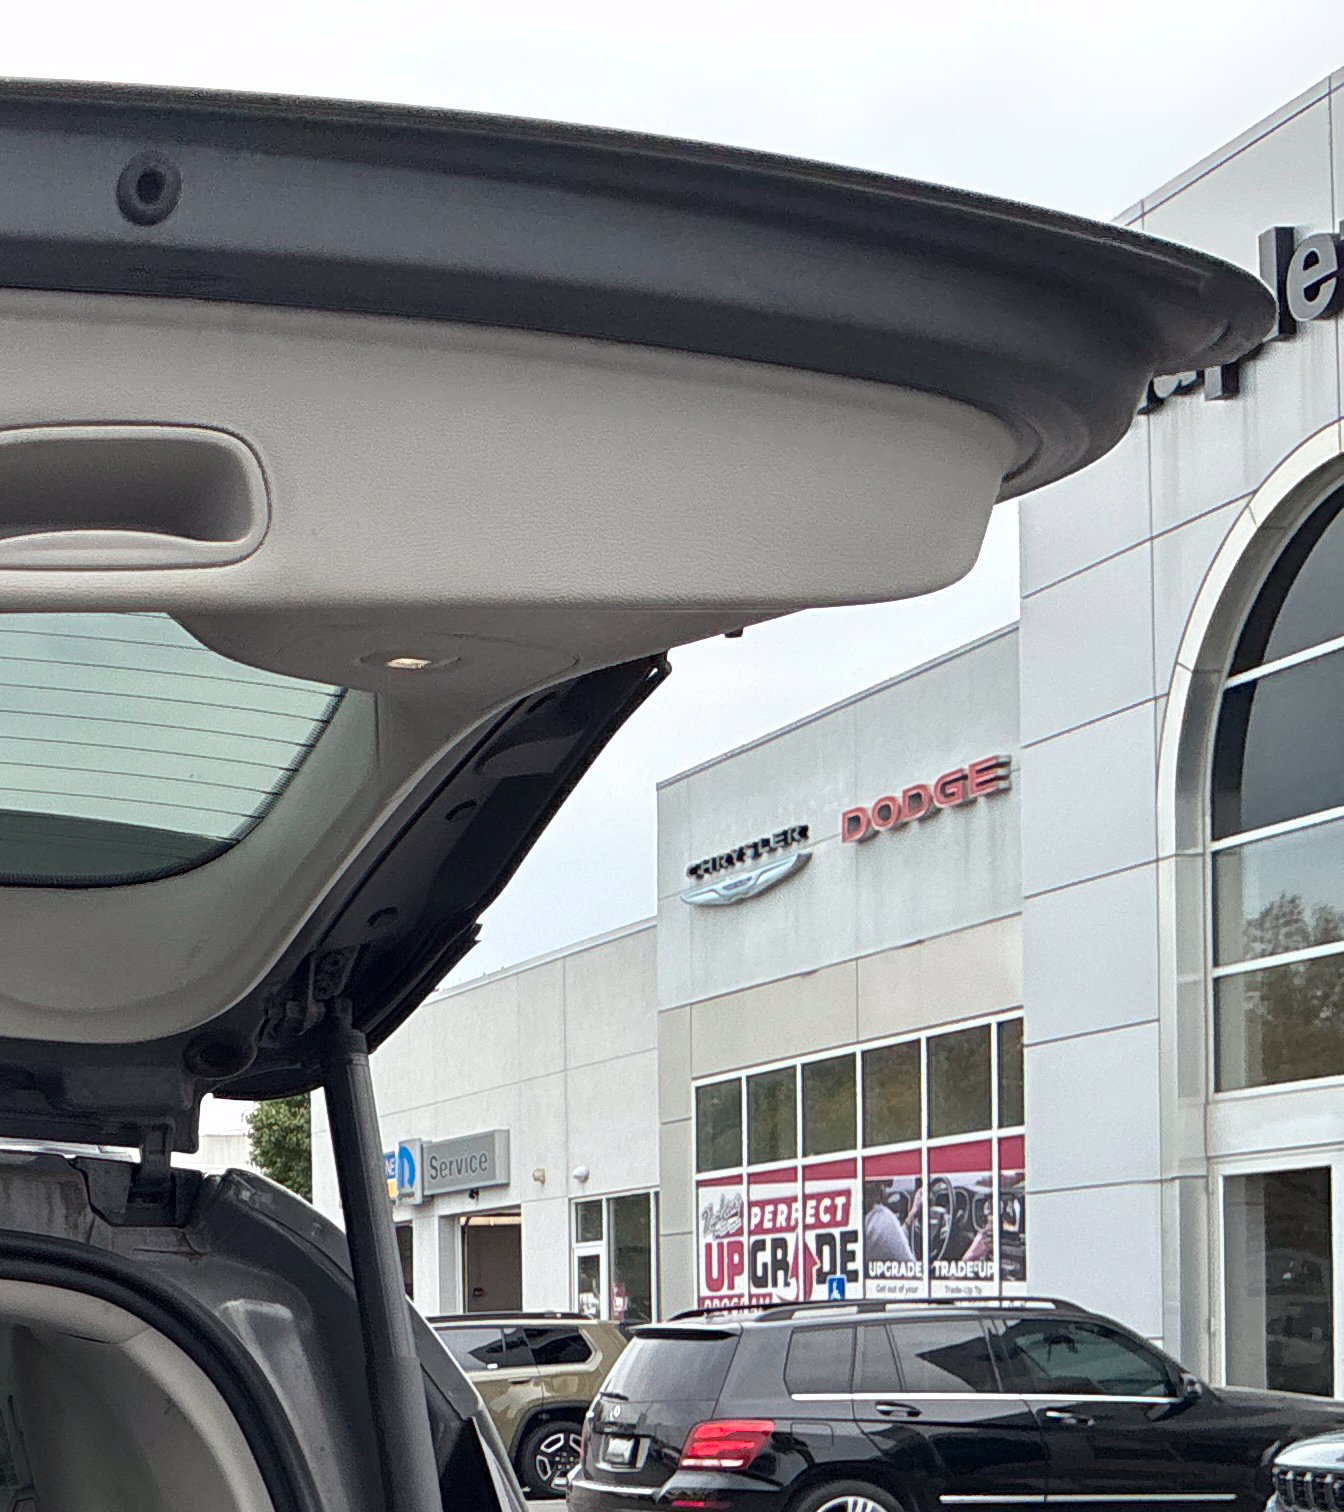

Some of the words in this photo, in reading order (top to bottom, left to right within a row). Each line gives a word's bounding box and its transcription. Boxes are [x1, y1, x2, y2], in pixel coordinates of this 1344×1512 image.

[841, 754, 1011, 844] DODGE
[686, 823, 810, 880] CHRYSLER
[429, 1152, 488, 1180] Service
[750, 1196, 846, 1230] PERFECT
[868, 1261, 923, 1278] UPGRADE
